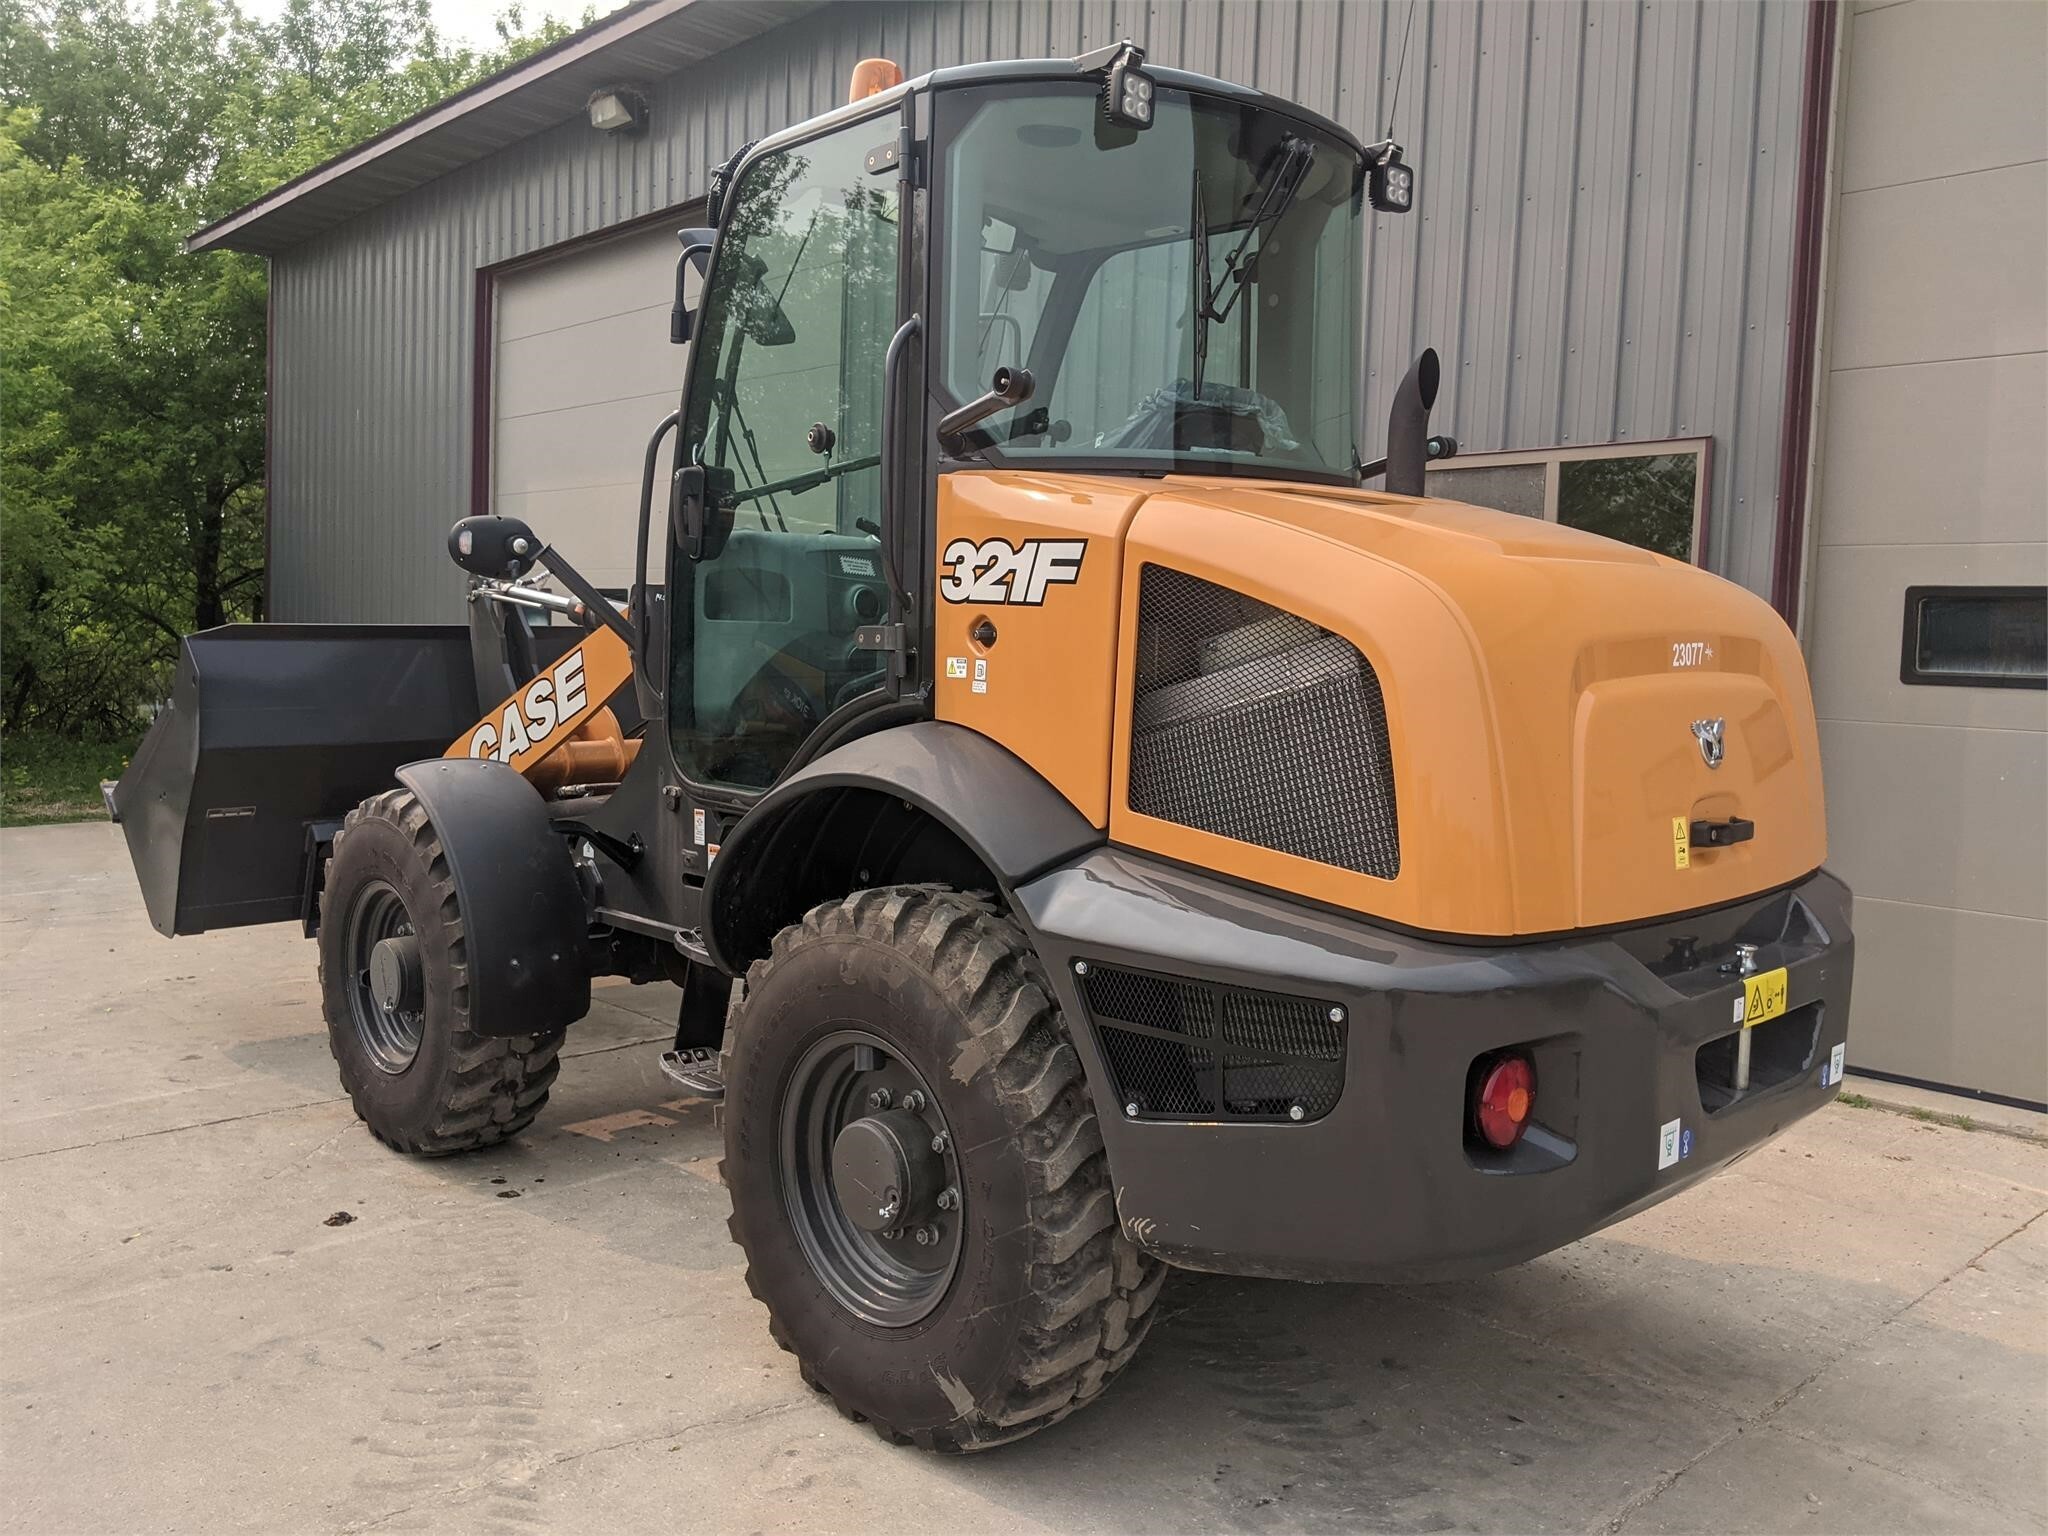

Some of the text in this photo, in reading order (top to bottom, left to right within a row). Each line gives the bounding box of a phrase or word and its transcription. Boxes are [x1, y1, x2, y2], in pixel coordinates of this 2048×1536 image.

[940, 537, 1088, 607] 321F
[1673, 642, 1704, 667] 23077
[470, 648, 588, 763] CASE
